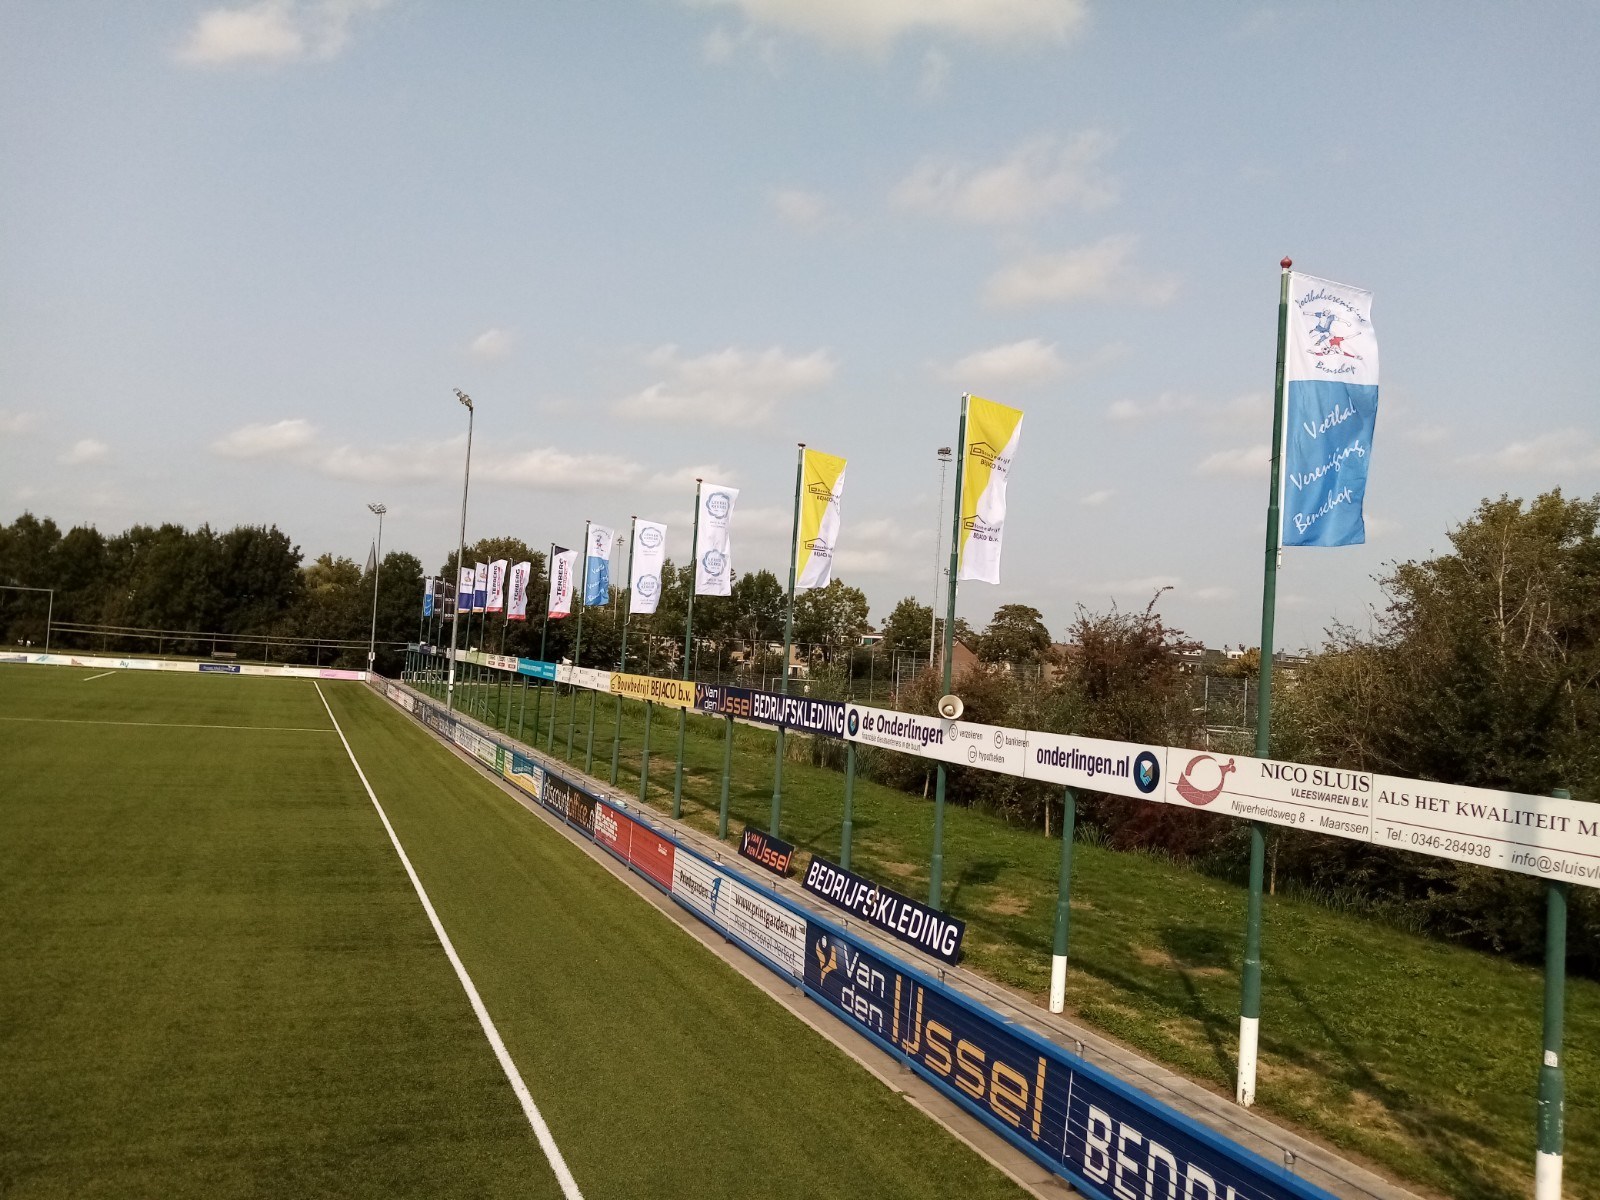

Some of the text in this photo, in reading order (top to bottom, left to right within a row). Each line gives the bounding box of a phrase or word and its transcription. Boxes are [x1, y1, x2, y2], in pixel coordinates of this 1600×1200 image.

[1303, 397, 1357, 439] Voetbal
[1289, 439, 1366, 491] Vereniging
[1292, 486, 1354, 535] Benschop
[617, 675, 649, 697] Bouwbedrijf
[678, 682, 691, 702] b.v.
[704, 685, 718, 698] Van
[704, 699, 717, 710] den
[753, 693, 844, 734] BEDRIJFSKLEDING
[862, 711, 943, 747] de Onderlingen
[959, 729, 983, 740] verzekeren
[1005, 735, 1030, 748] bankieren
[978, 750, 1005, 764] hypotheken
[1037, 746, 1130, 778] onderlingen.nl
[1260, 762, 1370, 793] NICO SLUIS
[1291, 787, 1369, 809] VLEESWAREN B.V.
[1378, 789, 1600, 837] ALS HET KWALITEIT M
[1231, 800, 1297, 824] Nijverheidsweg
[1298, 811, 1305, 823] 8
[1319, 815, 1369, 835] Maarssen
[1386, 826, 1408, 843] Tel.:
[1411, 831, 1491, 859] 0346-284938
[1511, 850, 1600, 881] info@sluisvl
[735, 893, 798, 942] www.printgarden.nl
[807, 861, 958, 956] BEDRIJFSKLEDING
[843, 944, 885, 998] Van
[841, 984, 884, 1033] den
[891, 973, 1048, 1142] IJssel
